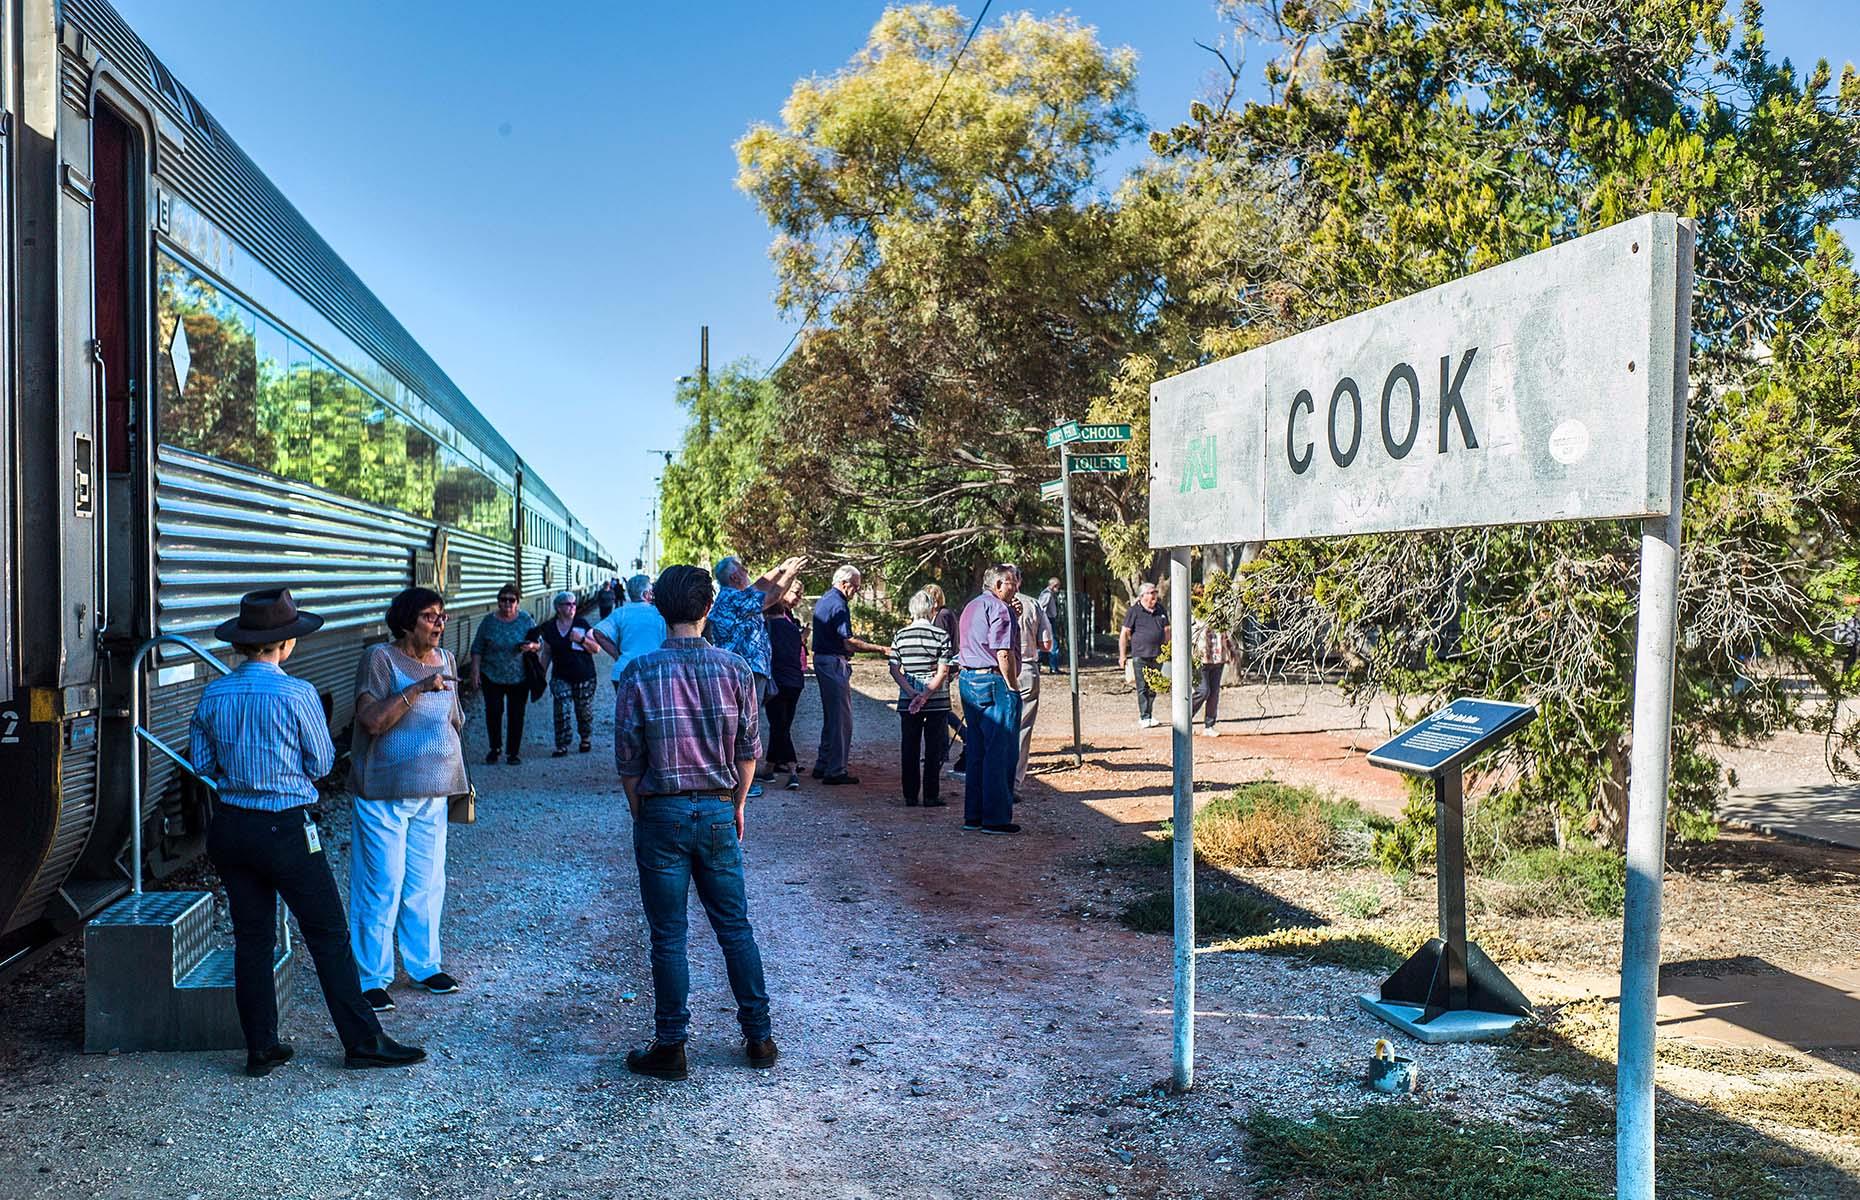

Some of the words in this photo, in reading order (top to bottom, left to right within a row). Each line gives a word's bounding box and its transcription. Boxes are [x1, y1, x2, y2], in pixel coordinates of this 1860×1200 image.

[1286, 346, 1479, 475] COOK
[1080, 426, 1123, 440] CHOOL
[1074, 456, 1121, 469] TOILETS
[1, 710, 19, 744] 2
